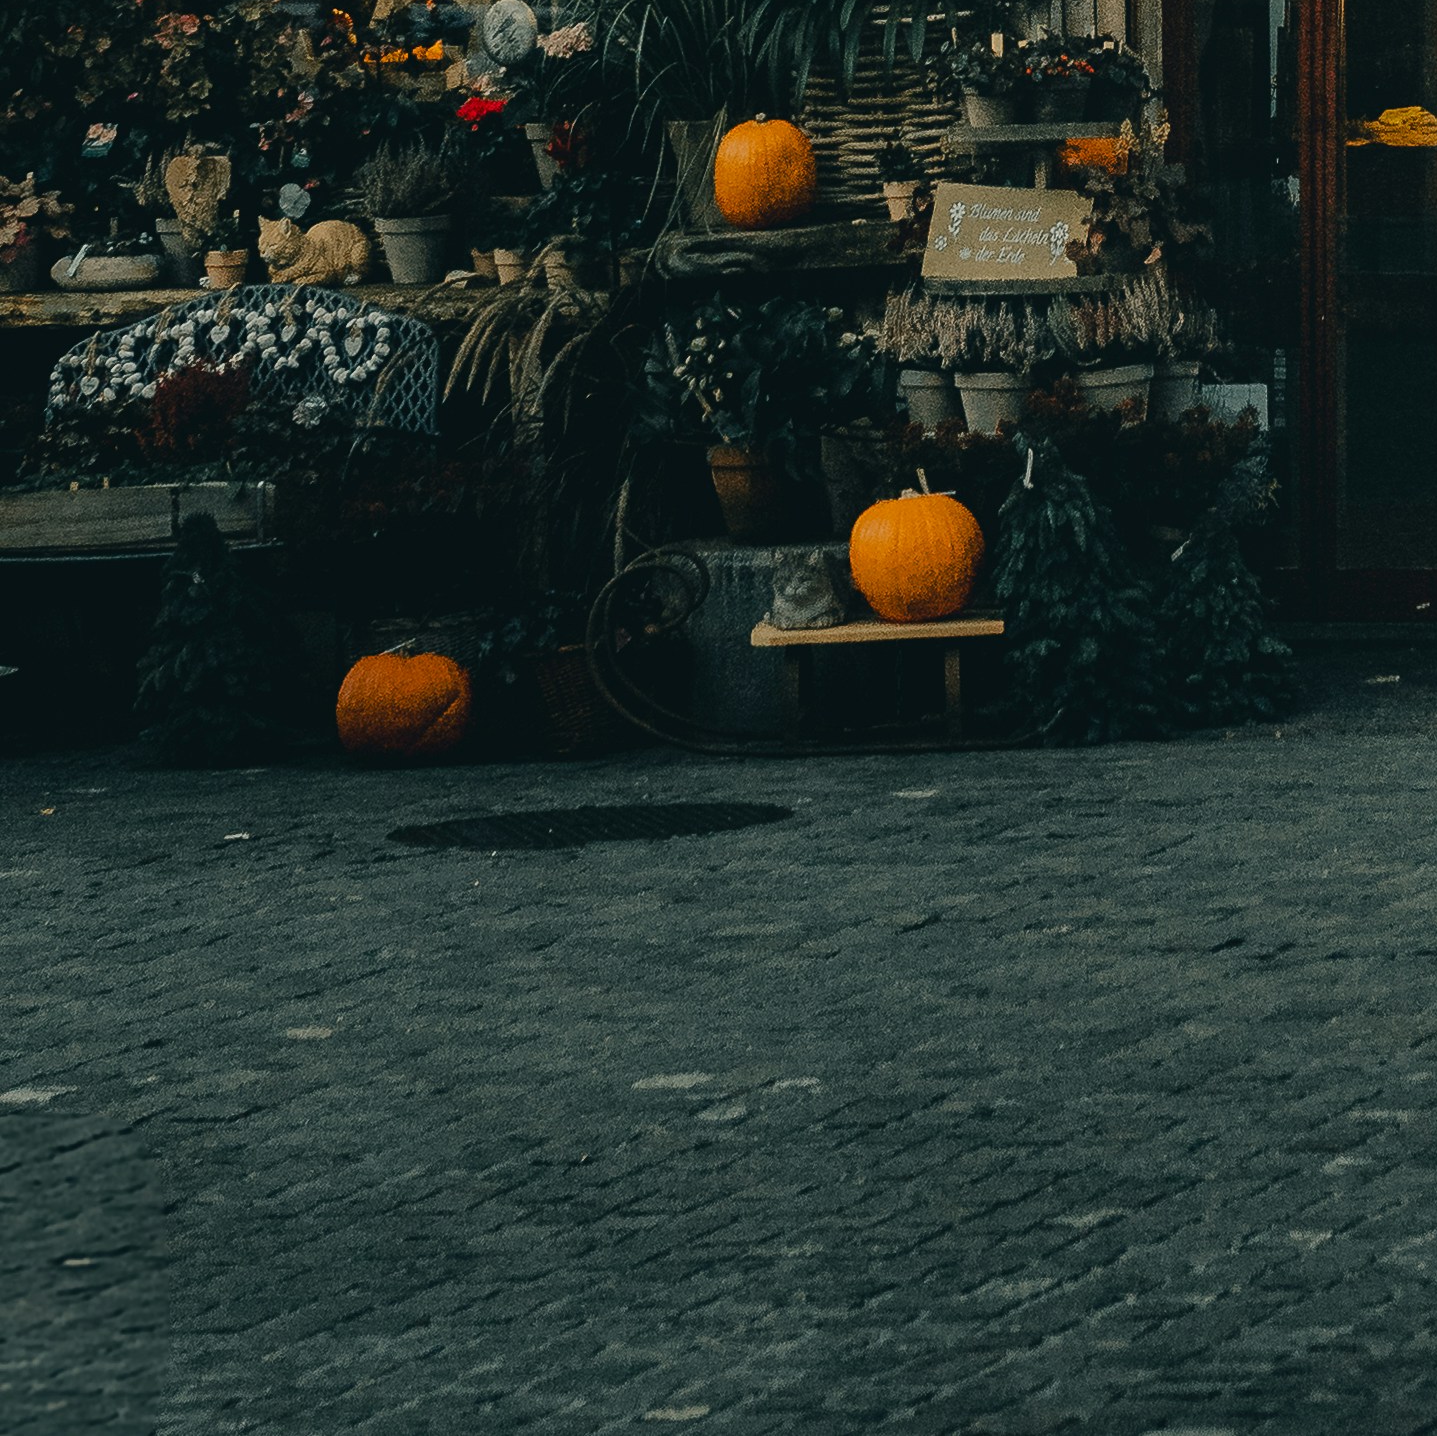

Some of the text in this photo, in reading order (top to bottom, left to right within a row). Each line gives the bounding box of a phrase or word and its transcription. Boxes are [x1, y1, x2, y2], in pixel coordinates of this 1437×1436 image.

[967, 203, 1042, 222] Blumen sind
[979, 226, 999, 242] das
[974, 245, 1025, 264] der Erde
